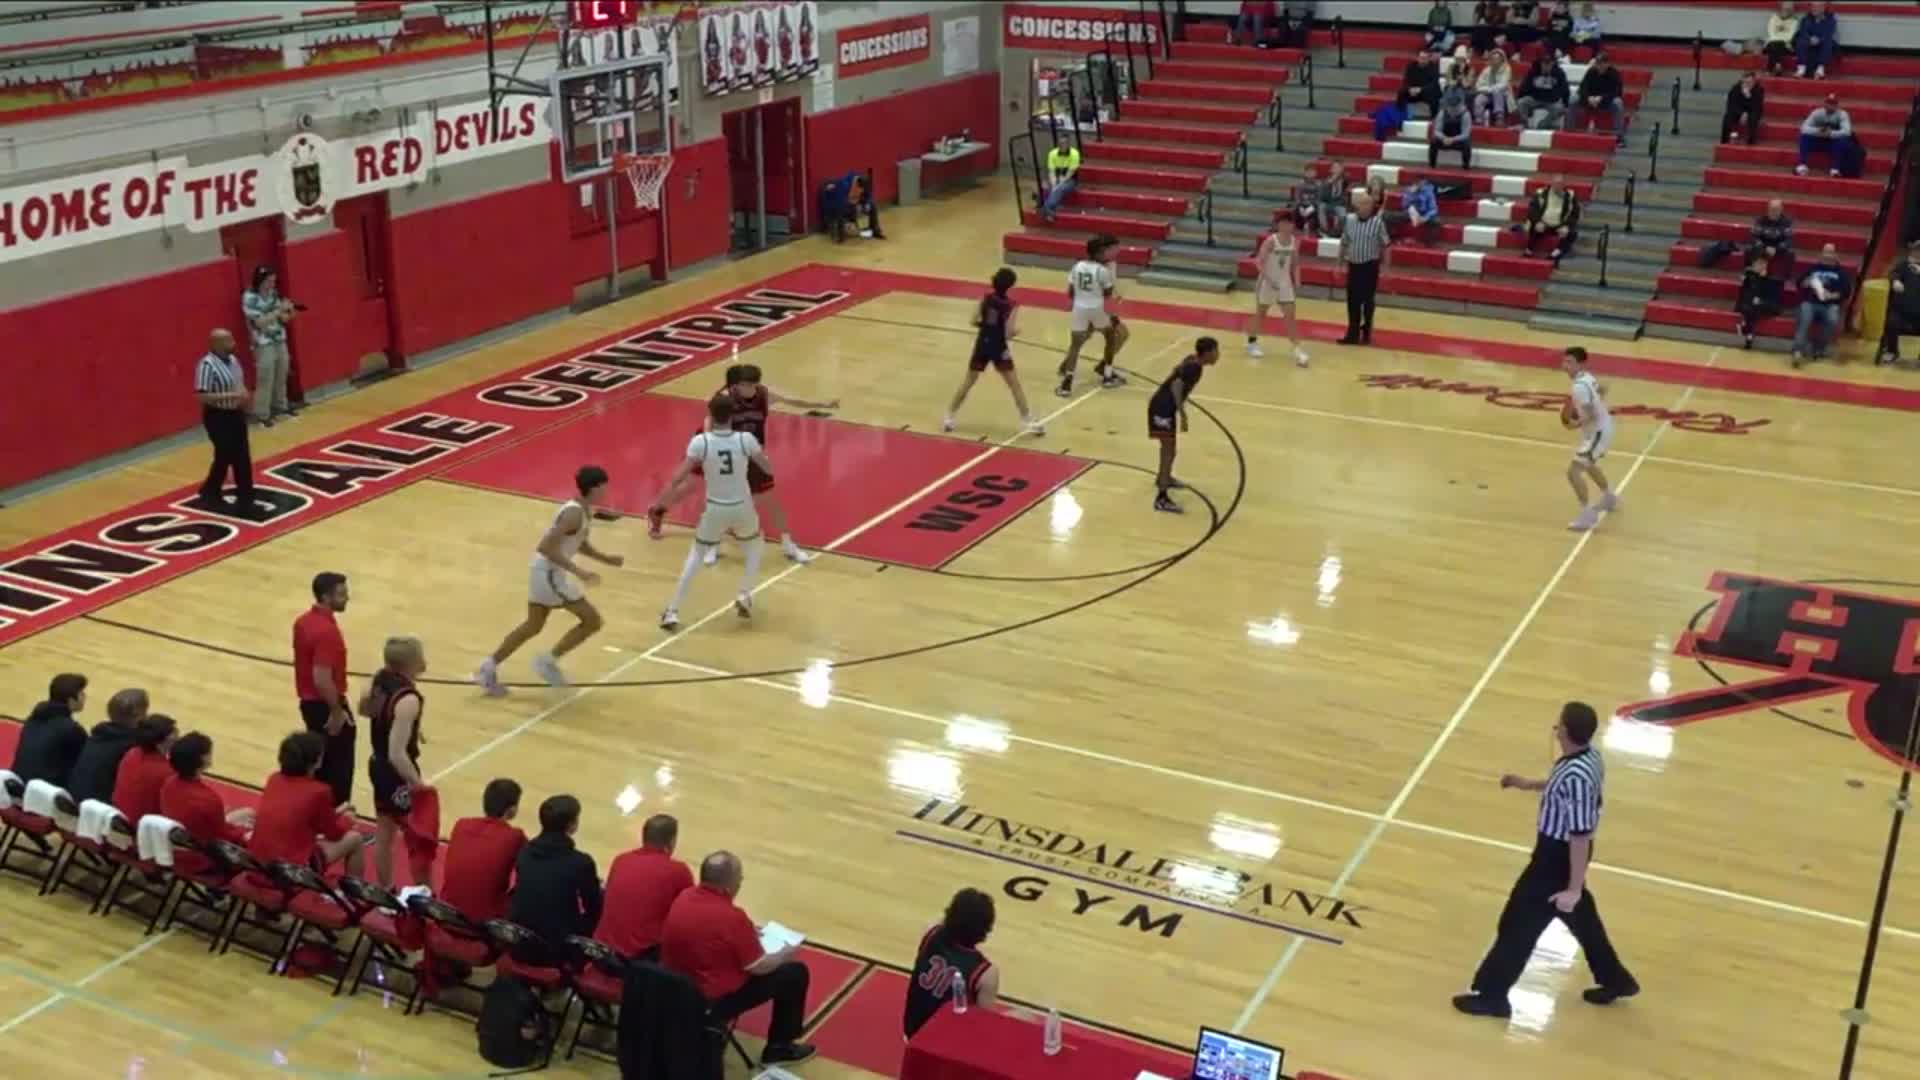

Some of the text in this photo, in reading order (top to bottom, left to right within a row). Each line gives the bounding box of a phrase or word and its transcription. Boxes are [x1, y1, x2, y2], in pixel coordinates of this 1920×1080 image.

[839, 27, 929, 65] CONCESSIONS
[1008, 15, 1157, 44] CONCESSIONS
[123, 169, 176, 220] OF
[184, 168, 258, 222] THE
[355, 137, 422, 184] RED
[434, 102, 536, 156] DEVILS
[1078, 271, 1093, 291] 12
[0, 288, 851, 629] INSDALE CENTRAL
[717, 449, 734, 476] 3
[903, 474, 1030, 533] WSC
[1002, 875, 1185, 938] GYM
